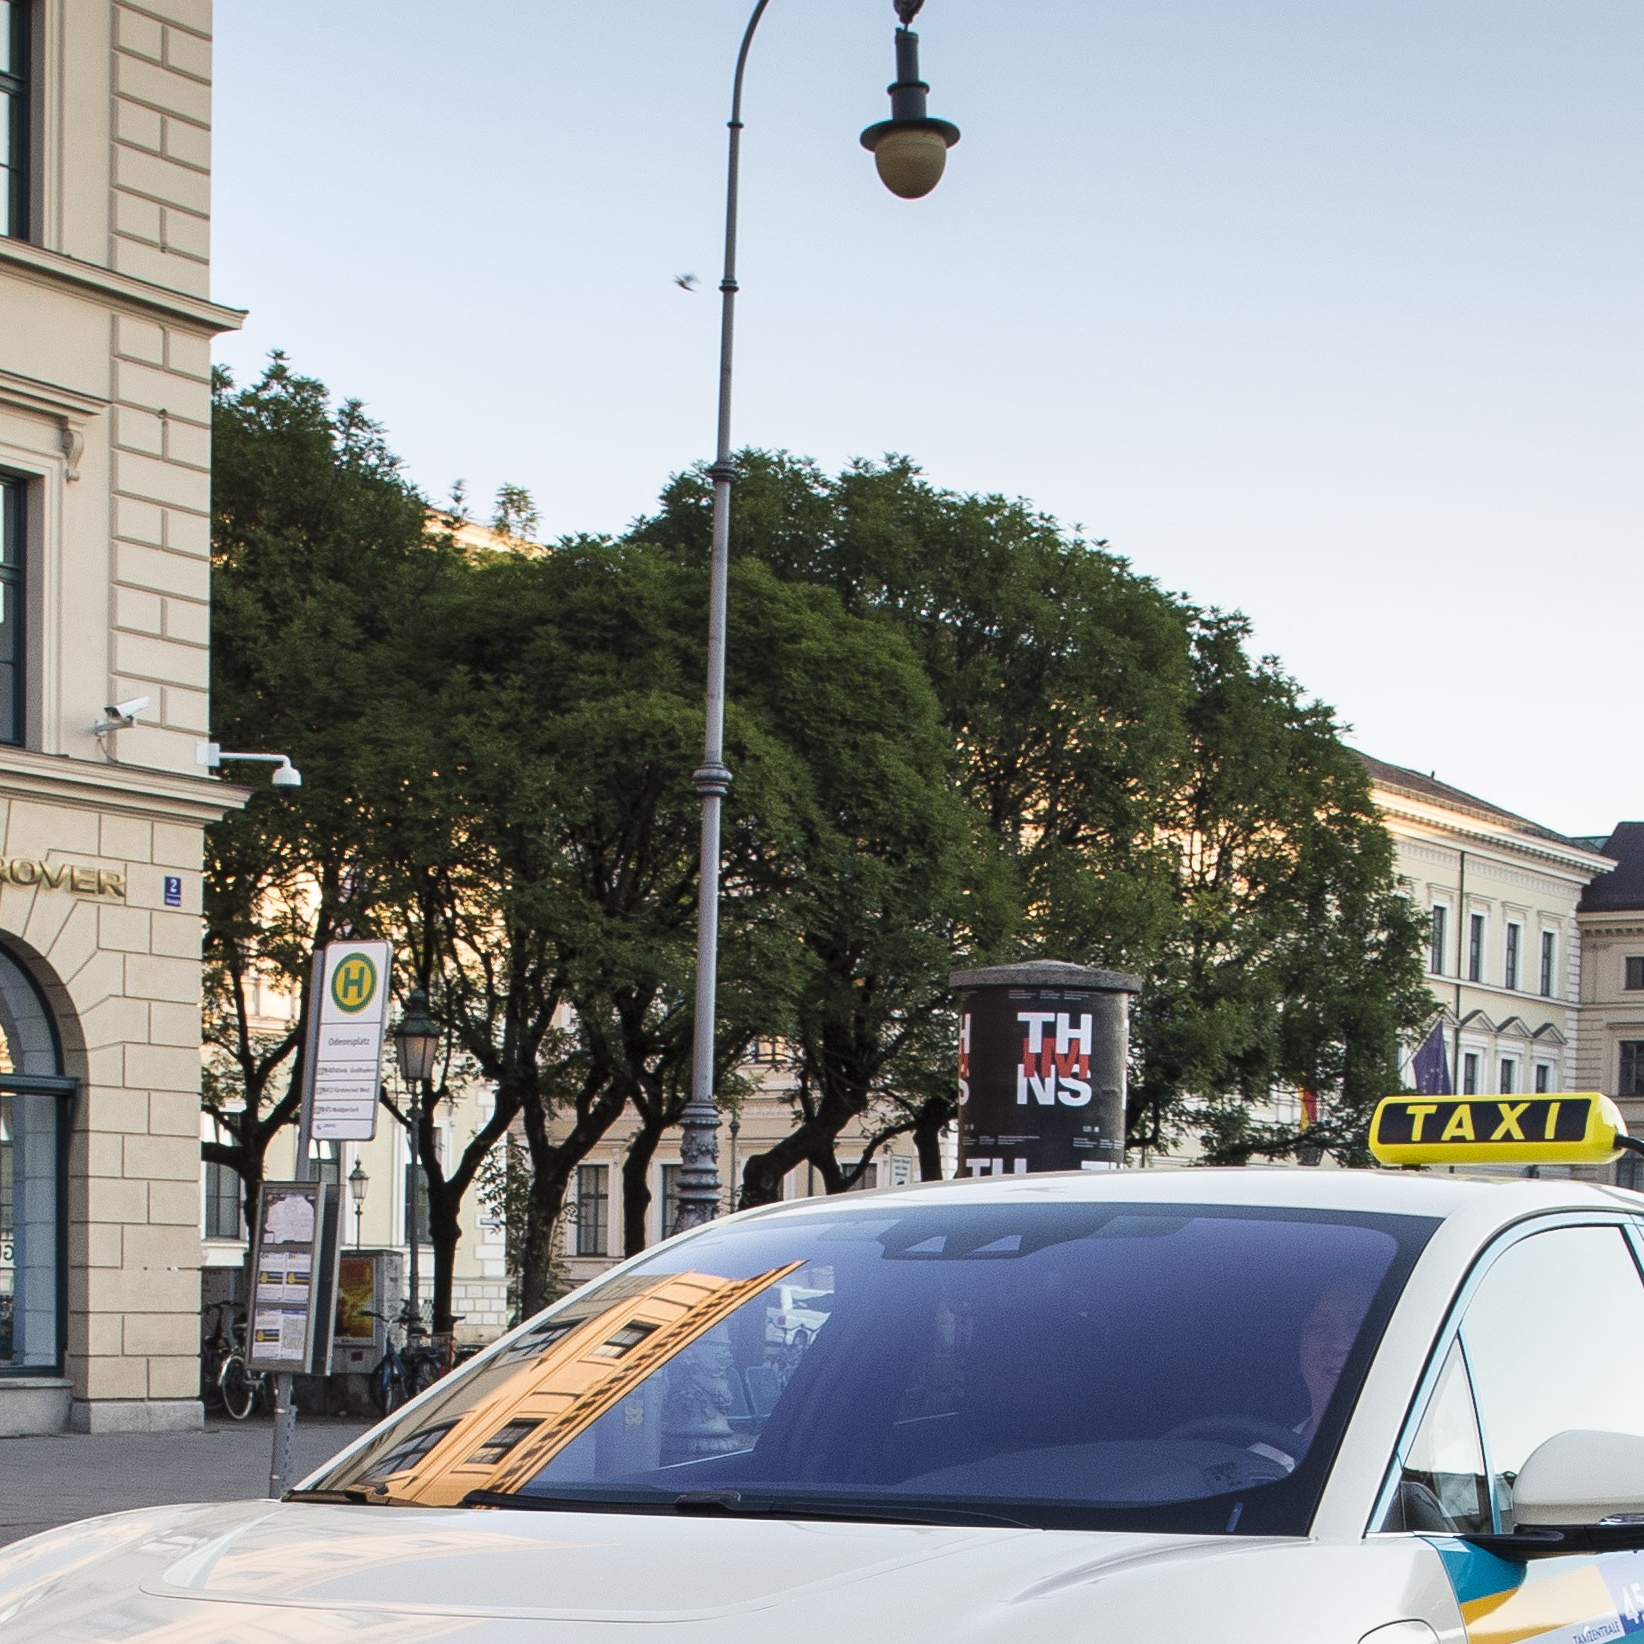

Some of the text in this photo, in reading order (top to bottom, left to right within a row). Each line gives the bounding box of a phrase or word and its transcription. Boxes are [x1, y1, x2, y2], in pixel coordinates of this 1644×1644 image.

[170, 879, 178, 893] 2
[342, 966, 365, 998] H
[1017, 1012, 1093, 1055] TH
[1016, 1063, 1093, 1107] NS
[1406, 1102, 1561, 1142] TAXI
